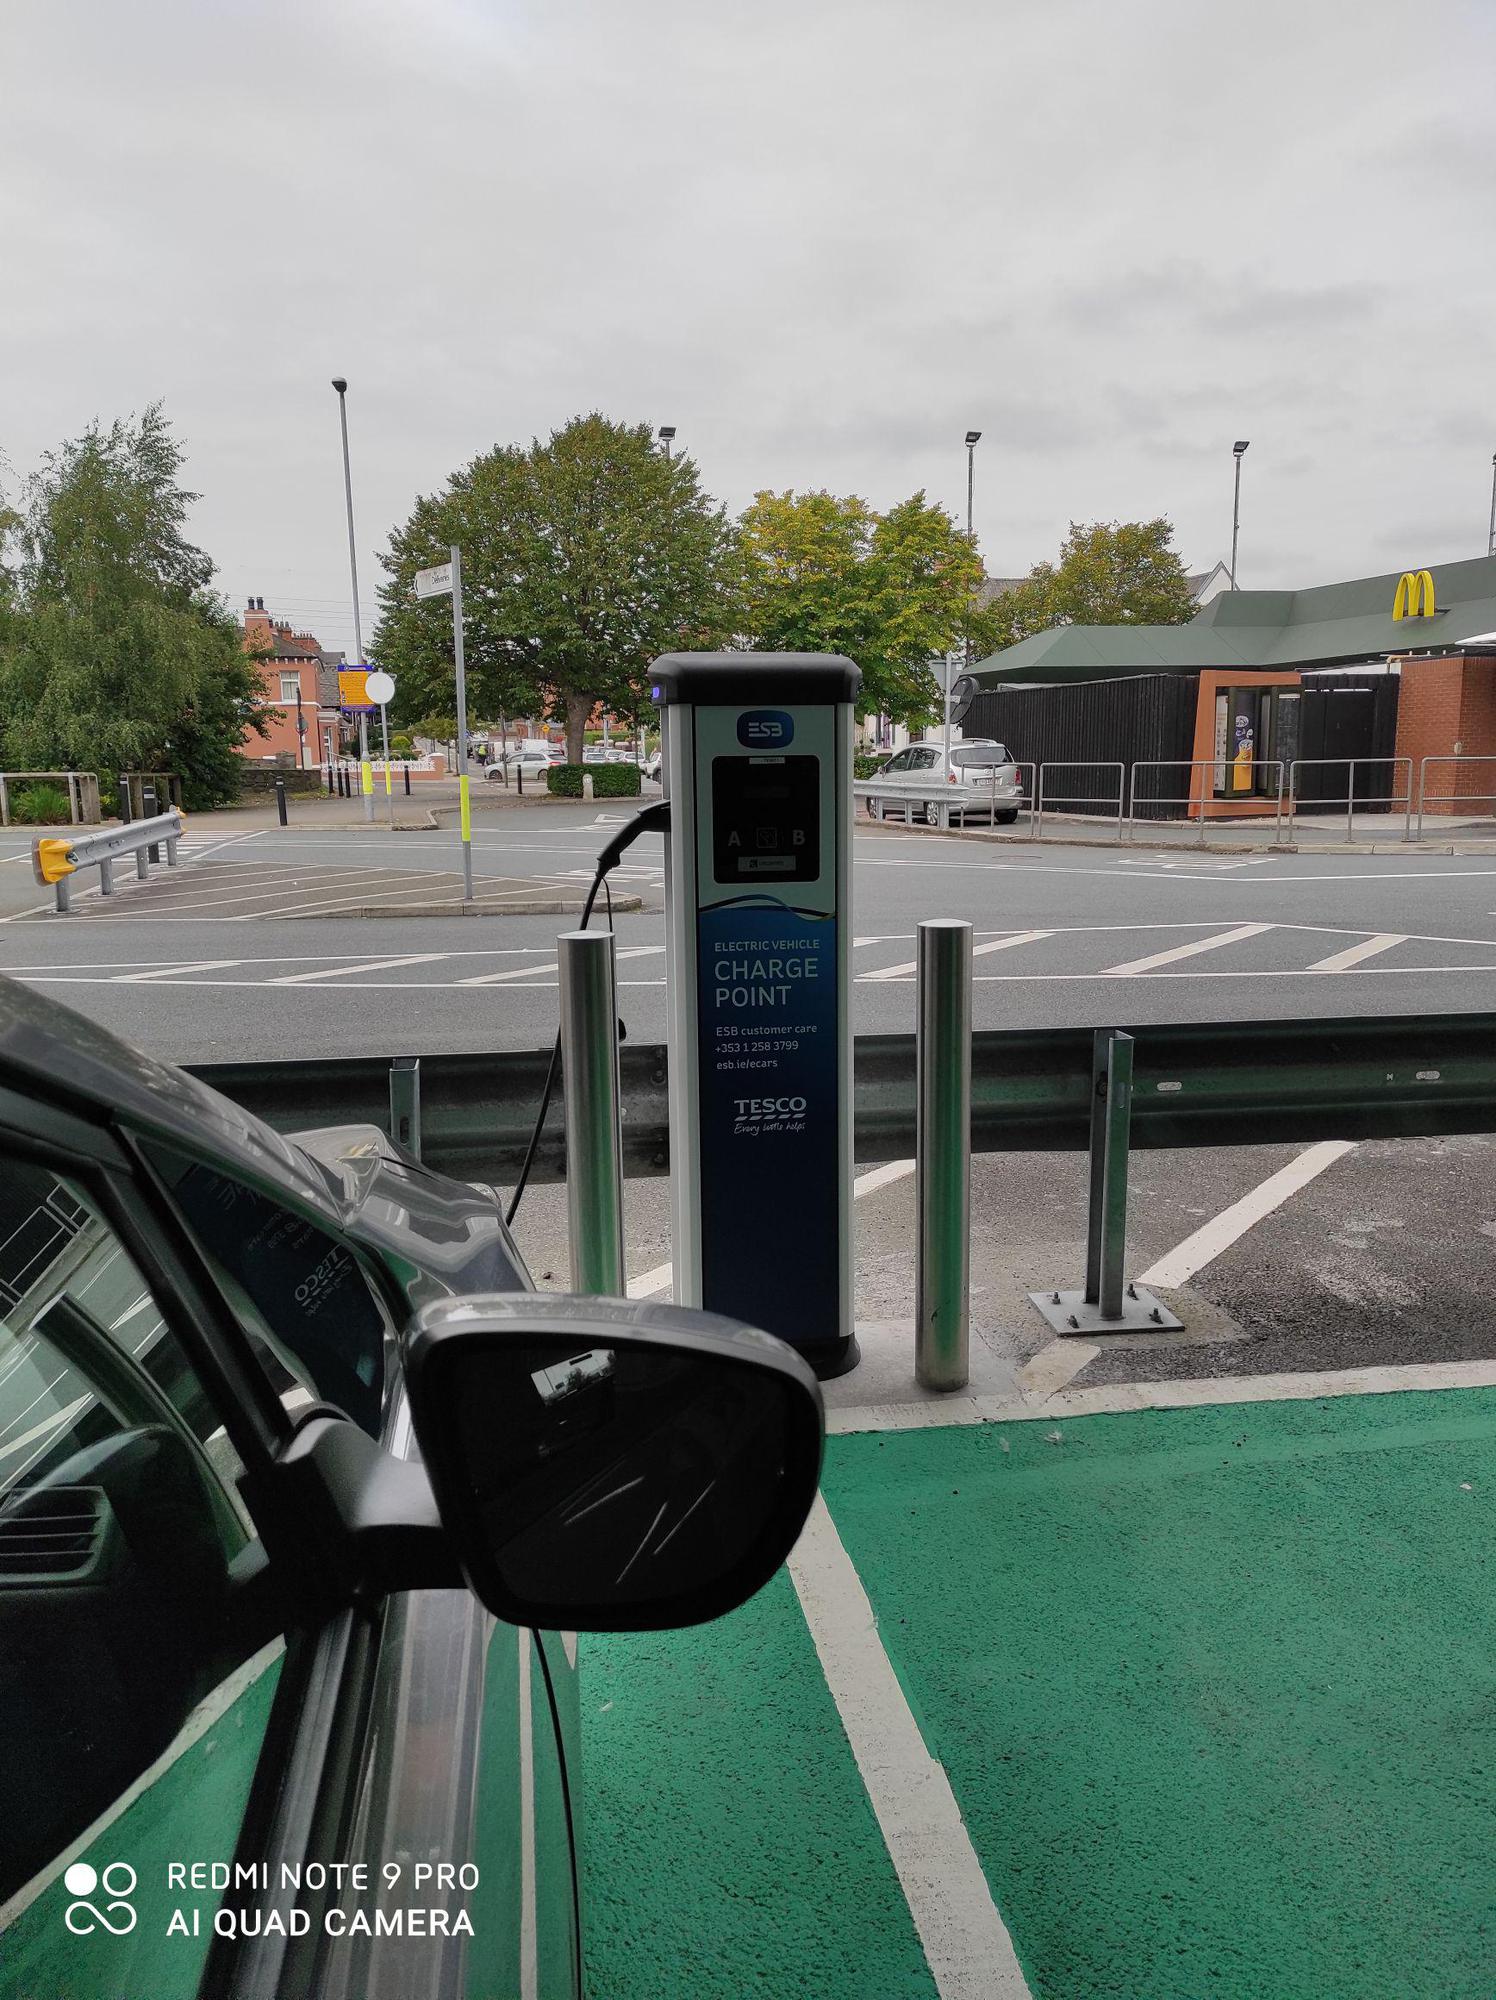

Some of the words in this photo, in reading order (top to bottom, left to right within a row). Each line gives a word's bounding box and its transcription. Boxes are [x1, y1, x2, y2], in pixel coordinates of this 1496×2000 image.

[749, 722, 783, 737] ESB
[728, 831, 742, 847] A
[792, 829, 806, 846] B
[714, 941, 769, 952] ELECTRIC
[771, 939, 820, 950] VEHICLE
[714, 958, 819, 981] CHARGE
[715, 985, 792, 1008] POINT
[716, 1026, 739, 1037] ESB
[740, 1025, 792, 1036] customer
[794, 1025, 818, 1034] care
[715, 1043, 741, 1053] +353
[743, 1043, 750, 1052] 1
[751, 1042, 771, 1051] 258
[773, 1040, 799, 1051] 3799
[716, 1059, 778, 1070] esb.ie/ecars
[733, 1097, 807, 1114] TESCO
[733, 1122, 760, 1136] Every
